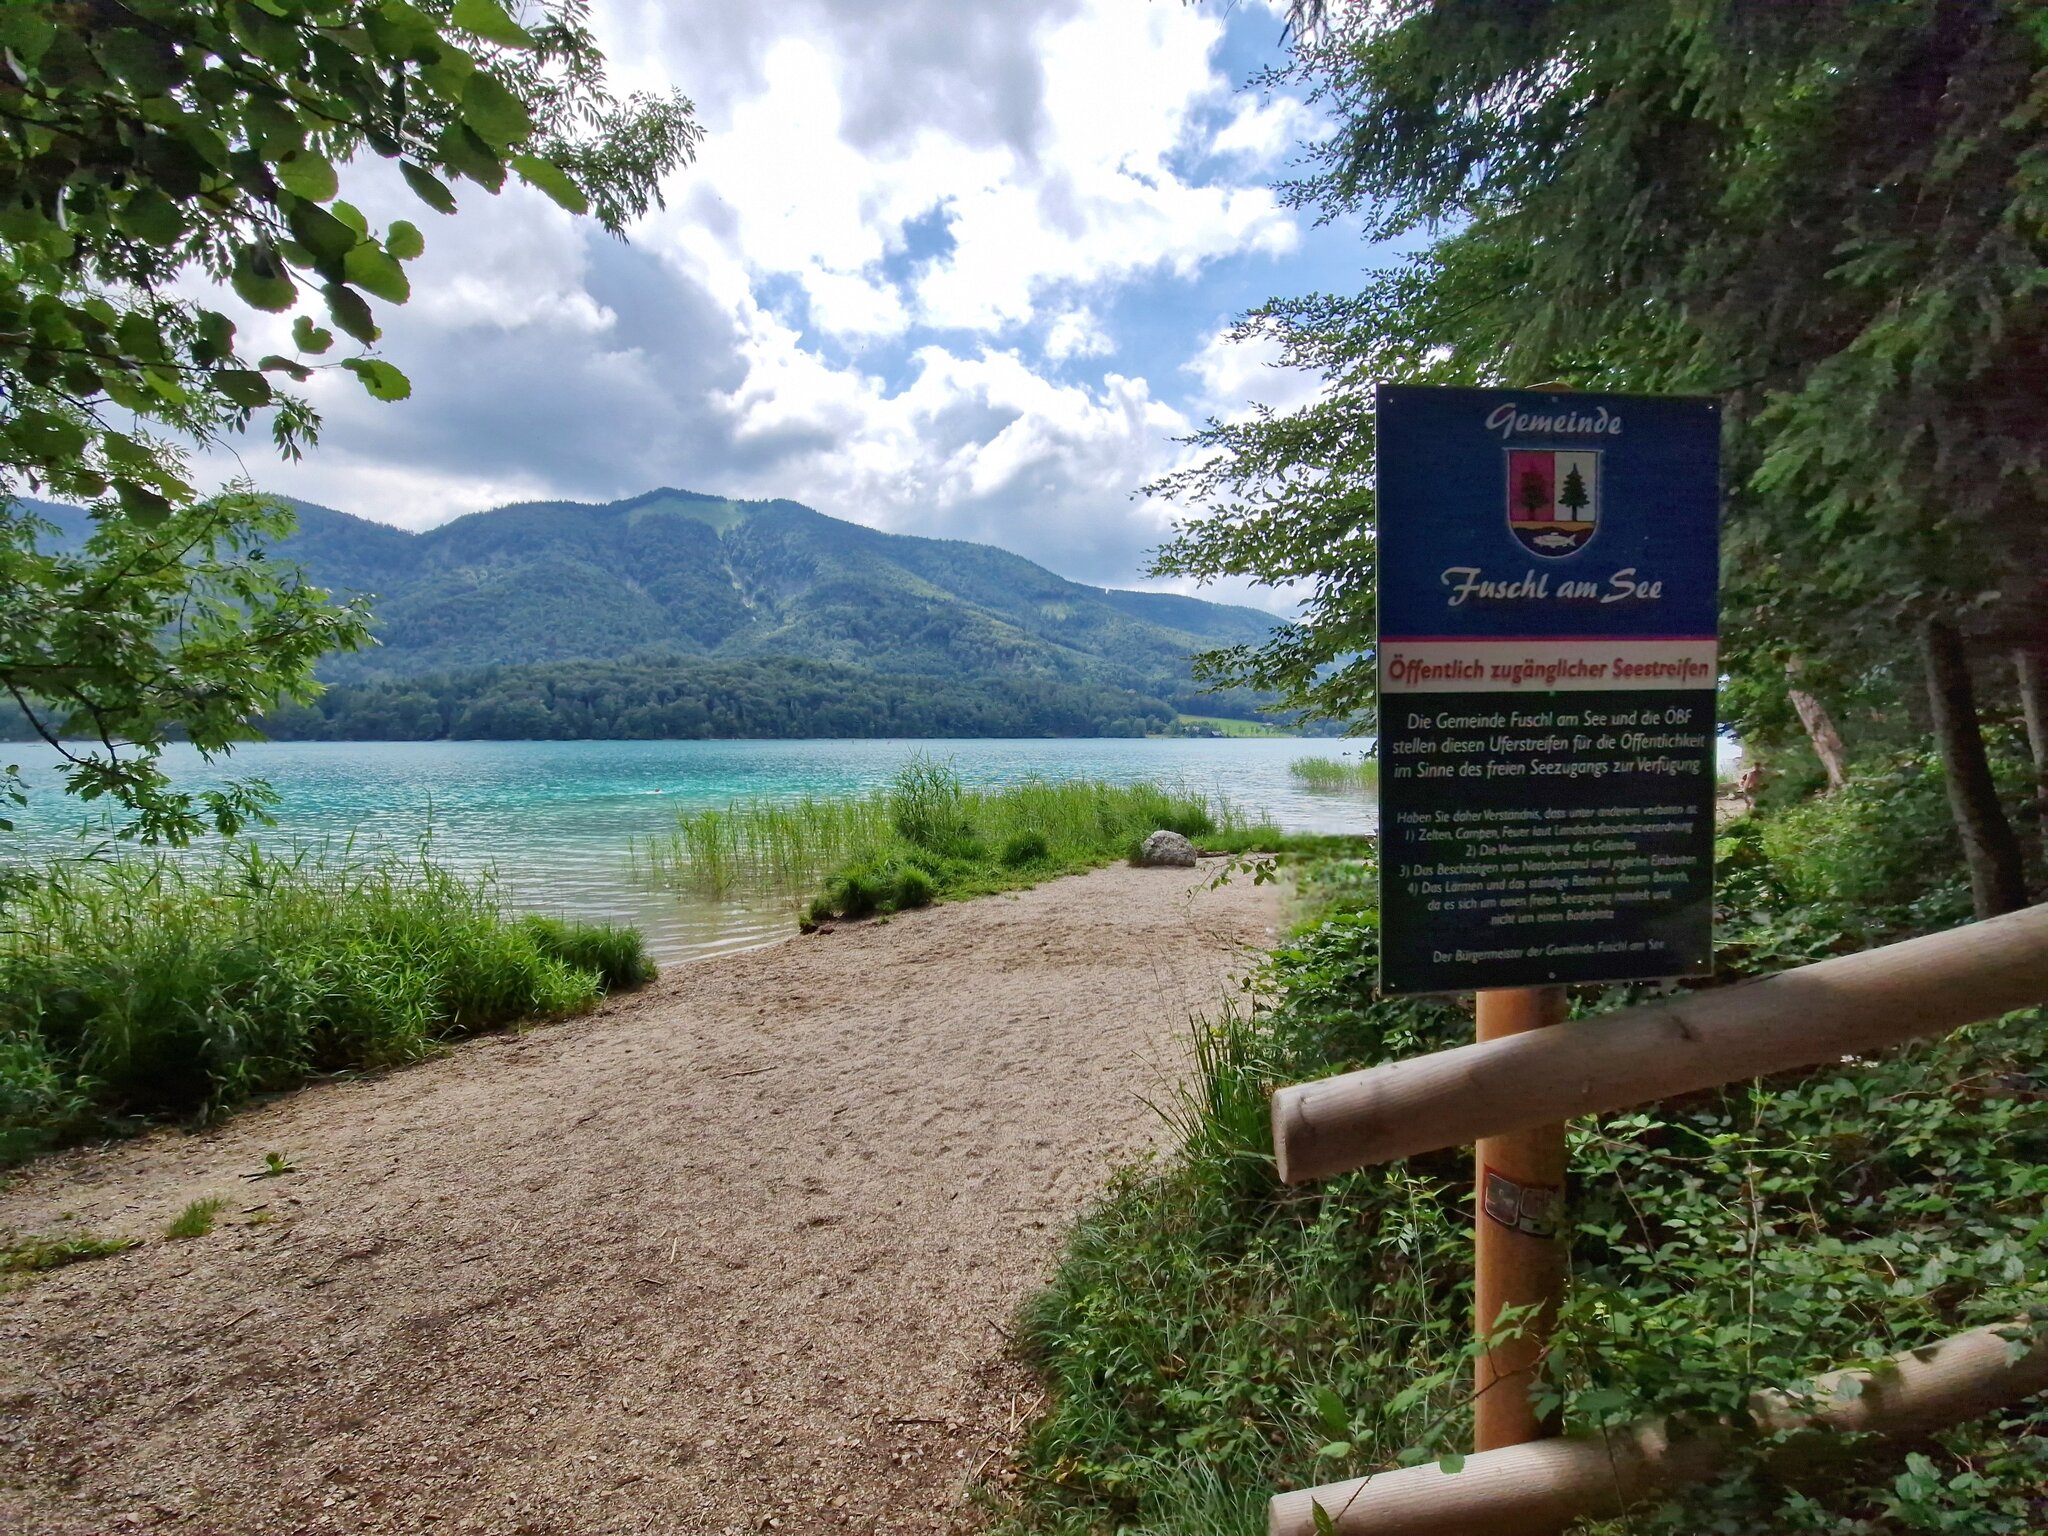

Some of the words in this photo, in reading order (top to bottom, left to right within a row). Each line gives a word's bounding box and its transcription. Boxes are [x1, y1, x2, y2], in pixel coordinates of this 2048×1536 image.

[1485, 402, 1622, 439] Gemeinde
[1440, 566, 1548, 607] Fuschl
[1556, 580, 1597, 599] am
[1600, 568, 1662, 603] See
[1389, 654, 1484, 684] Öffentlich
[1490, 658, 1608, 683] zugänglicher
[1612, 657, 1708, 681] Seestreifen
[1407, 713, 1432, 729] Die
[1436, 712, 1506, 729] Gemeinde
[1510, 711, 1552, 728] Fuschl
[1556, 714, 1578, 727] am
[1583, 710, 1607, 726] See
[1611, 710, 1637, 726] und
[1640, 710, 1660, 726] die
[1392, 737, 1436, 754] stellen
[1441, 737, 1485, 753] diesen
[1489, 735, 1569, 755] Uferstreifen
[1573, 734, 1593, 753] für
[1596, 734, 1616, 749] die
[1620, 730, 1705, 752] Öffentlichkeit
[1394, 763, 1412, 778] im
[1416, 761, 1454, 778] Sinne
[1459, 761, 1482, 777] des
[1487, 760, 1525, 779] freien
[1530, 758, 1608, 778] Seezugangs
[1612, 761, 1634, 773] zur
[1637, 755, 1701, 776] Verfügung
[1397, 811, 1432, 824] Haben
[1435, 810, 1450, 823] Sie
[1452, 809, 1482, 822] daher
[1479, 844, 1497, 856] Die
[1413, 864, 1434, 876] Das
[1421, 881, 1442, 894] Das
[1432, 950, 1452, 963] Der
